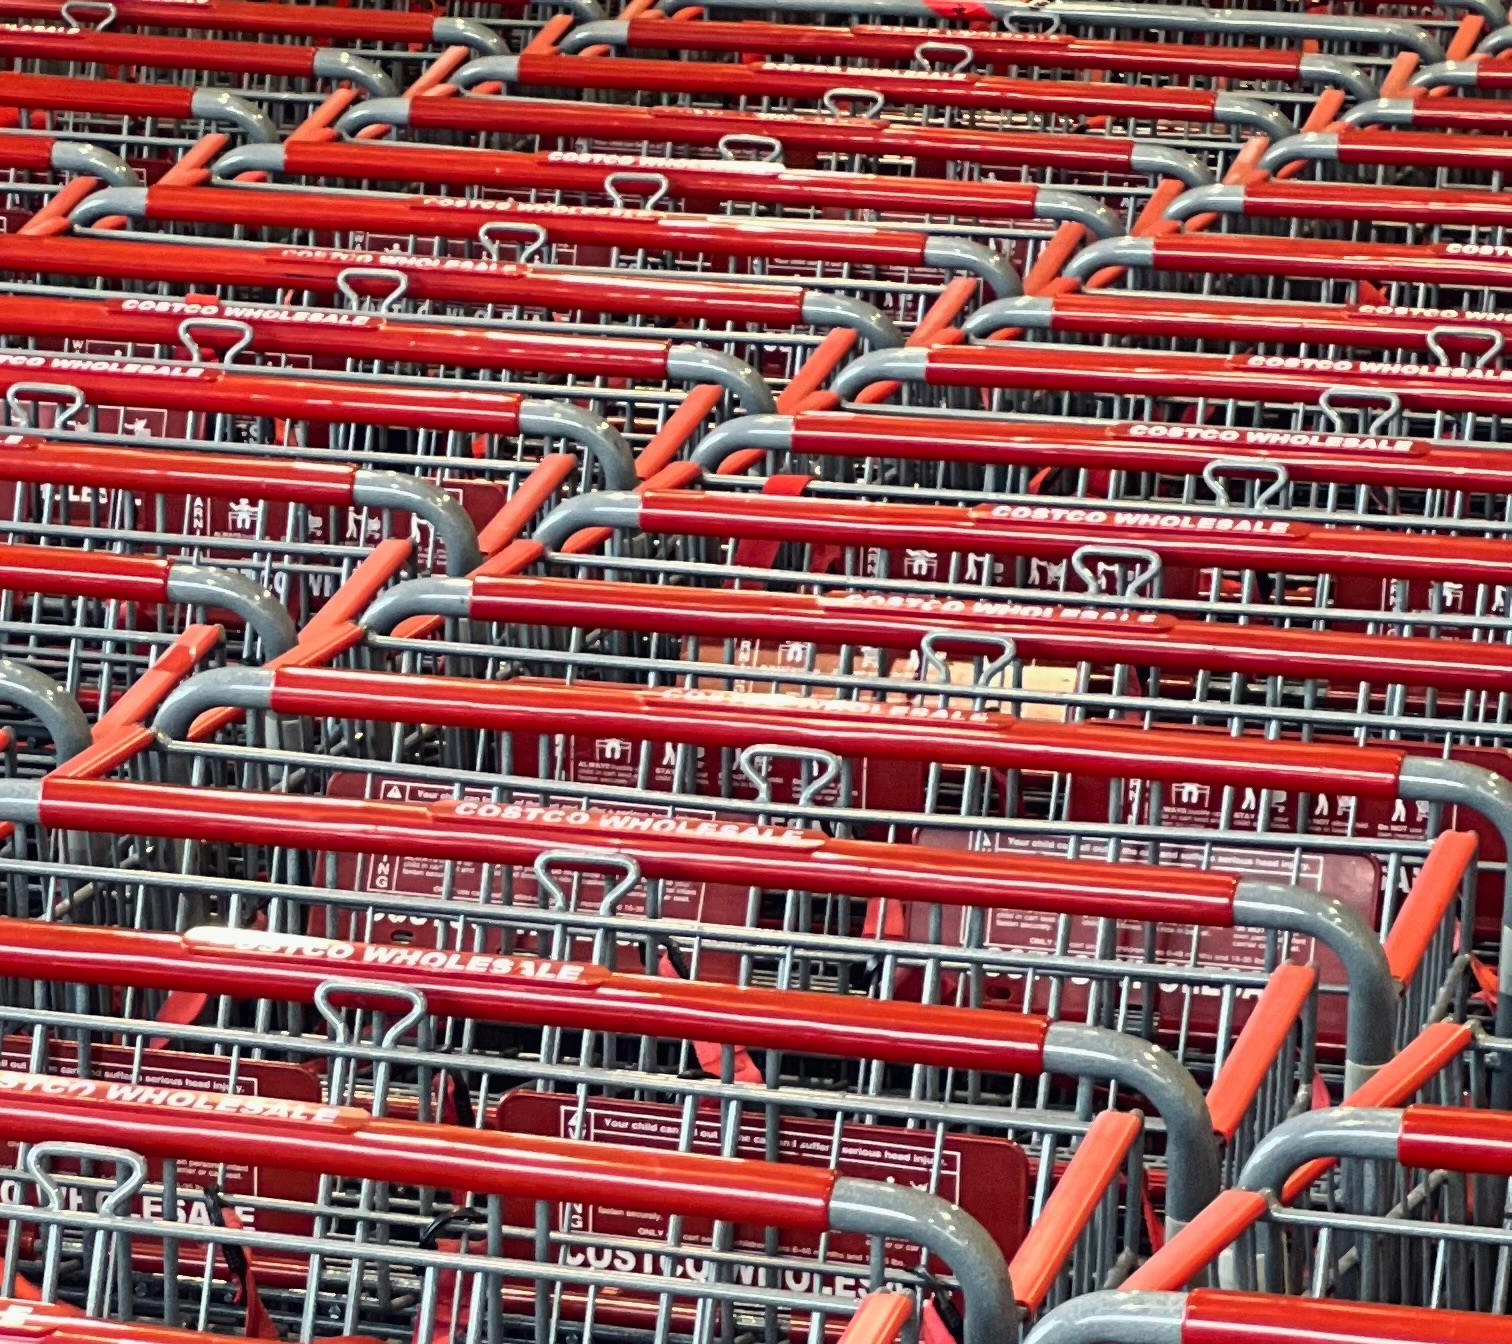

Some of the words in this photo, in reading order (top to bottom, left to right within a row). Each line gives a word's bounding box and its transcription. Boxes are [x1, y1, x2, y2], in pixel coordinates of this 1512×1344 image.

[121, 299, 219, 315] COSTCO
[223, 306, 370, 325] WHOLESALE
[50, 357, 205, 377] WHOLESALE
[1247, 355, 1353, 371] COSTCO
[1129, 425, 1240, 442] COSTCO
[1245, 431, 1414, 453] WHOLESALE
[991, 504, 1107, 524] COSTCO
[1113, 512, 1290, 534] WHOLESALE
[455, 801, 590, 826] COSTCO
[598, 814, 804, 844] WHOLESALE
[1007, 836, 1028, 848] Your
[1217, 855, 1254, 867] serious
[1255, 857, 1279, 869] head
[363, 943, 584, 982] WHOLESALE
[10, 1061, 28, 1070] out
[144, 1074, 184, 1087] serious
[185, 1077, 211, 1090] head
[104, 1083, 340, 1123] WHOLESALE
[604, 1118, 629, 1130] Your
[631, 1121, 658, 1133] child
[659, 1125, 680, 1134] can
[700, 1130, 718, 1139] out
[841, 1146, 882, 1159] serious
[884, 1149, 911, 1162] head
